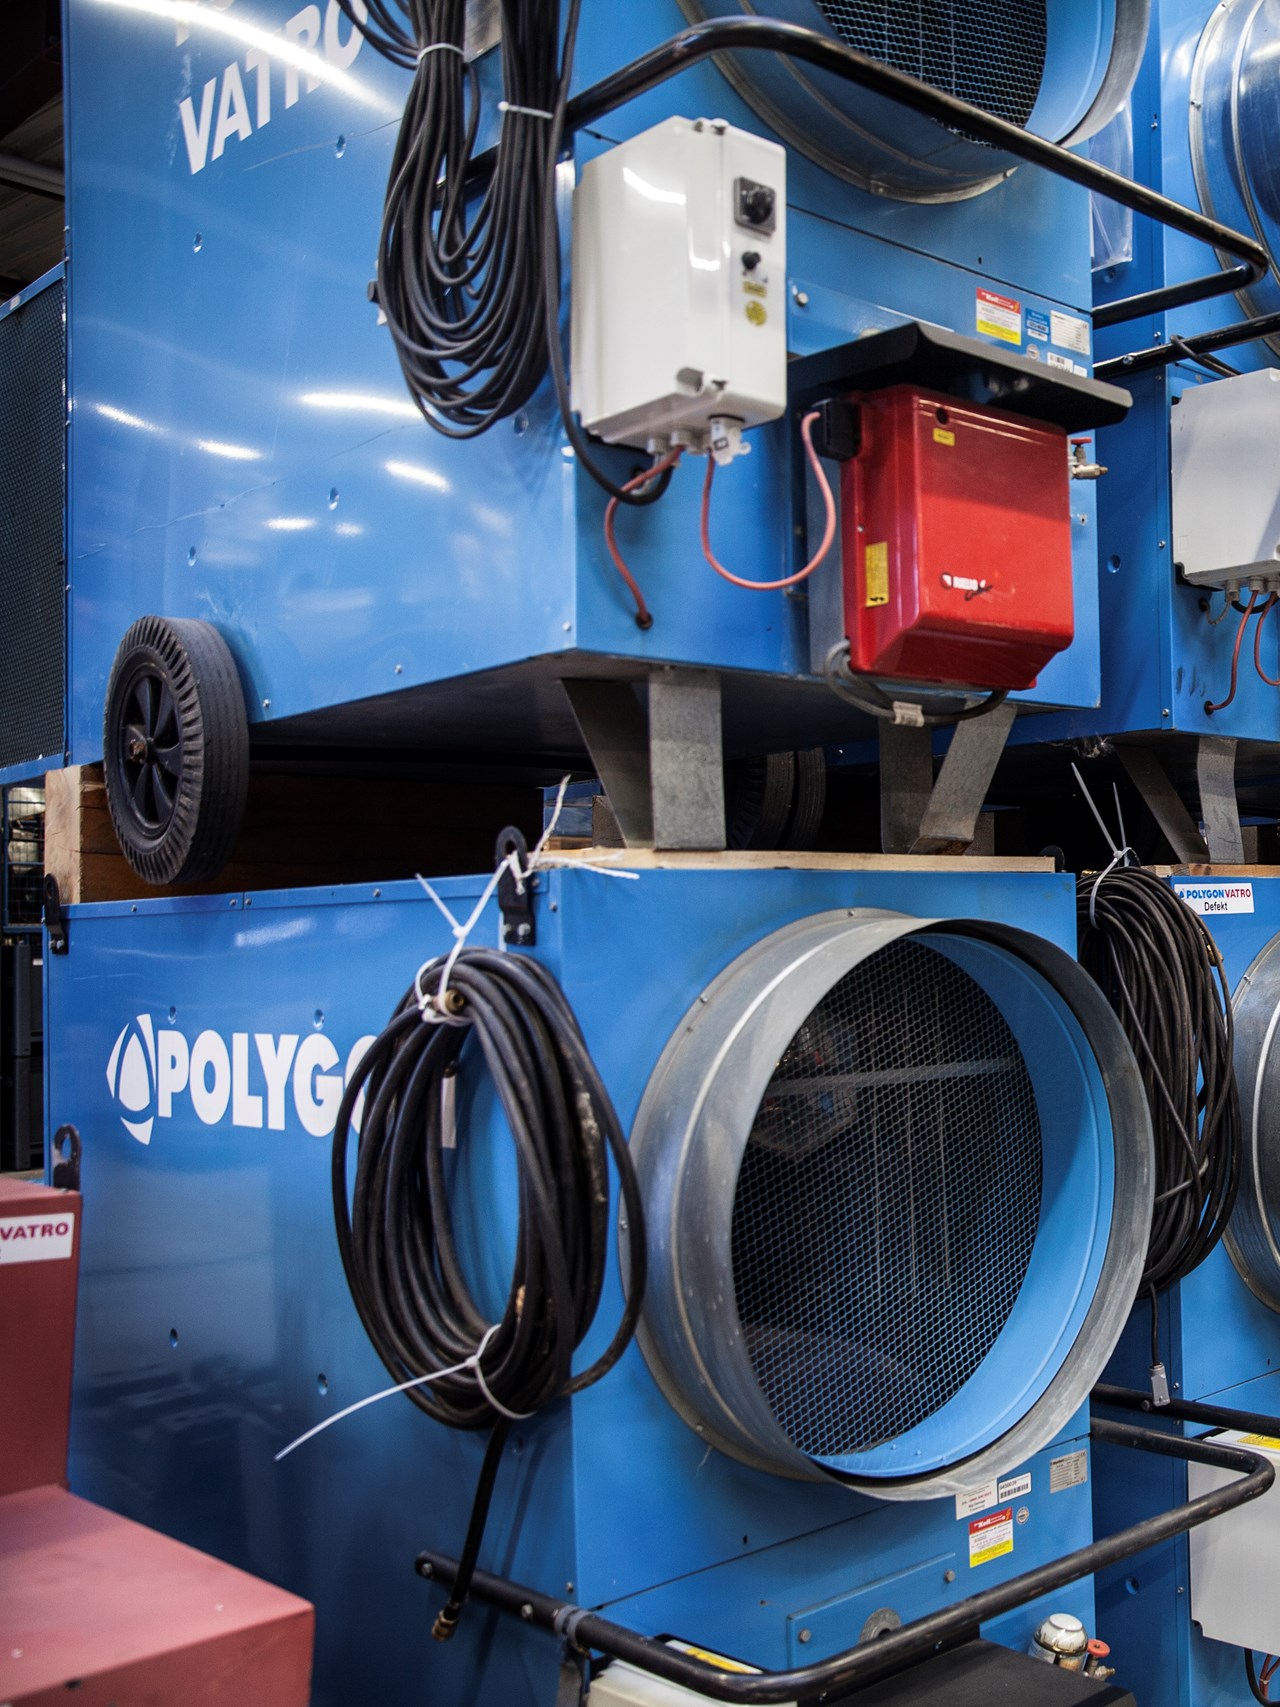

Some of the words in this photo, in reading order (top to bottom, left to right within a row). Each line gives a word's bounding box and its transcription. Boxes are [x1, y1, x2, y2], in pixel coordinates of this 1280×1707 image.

[179, 0, 367, 175] VATRO
[1186, 889, 1224, 899] POLYGON
[1225, 888, 1252, 898] VATRO
[1204, 901, 1228, 911] Defekt
[157, 1029, 456, 1149] POLYG
[0, 1222, 69, 1241] VATRO
